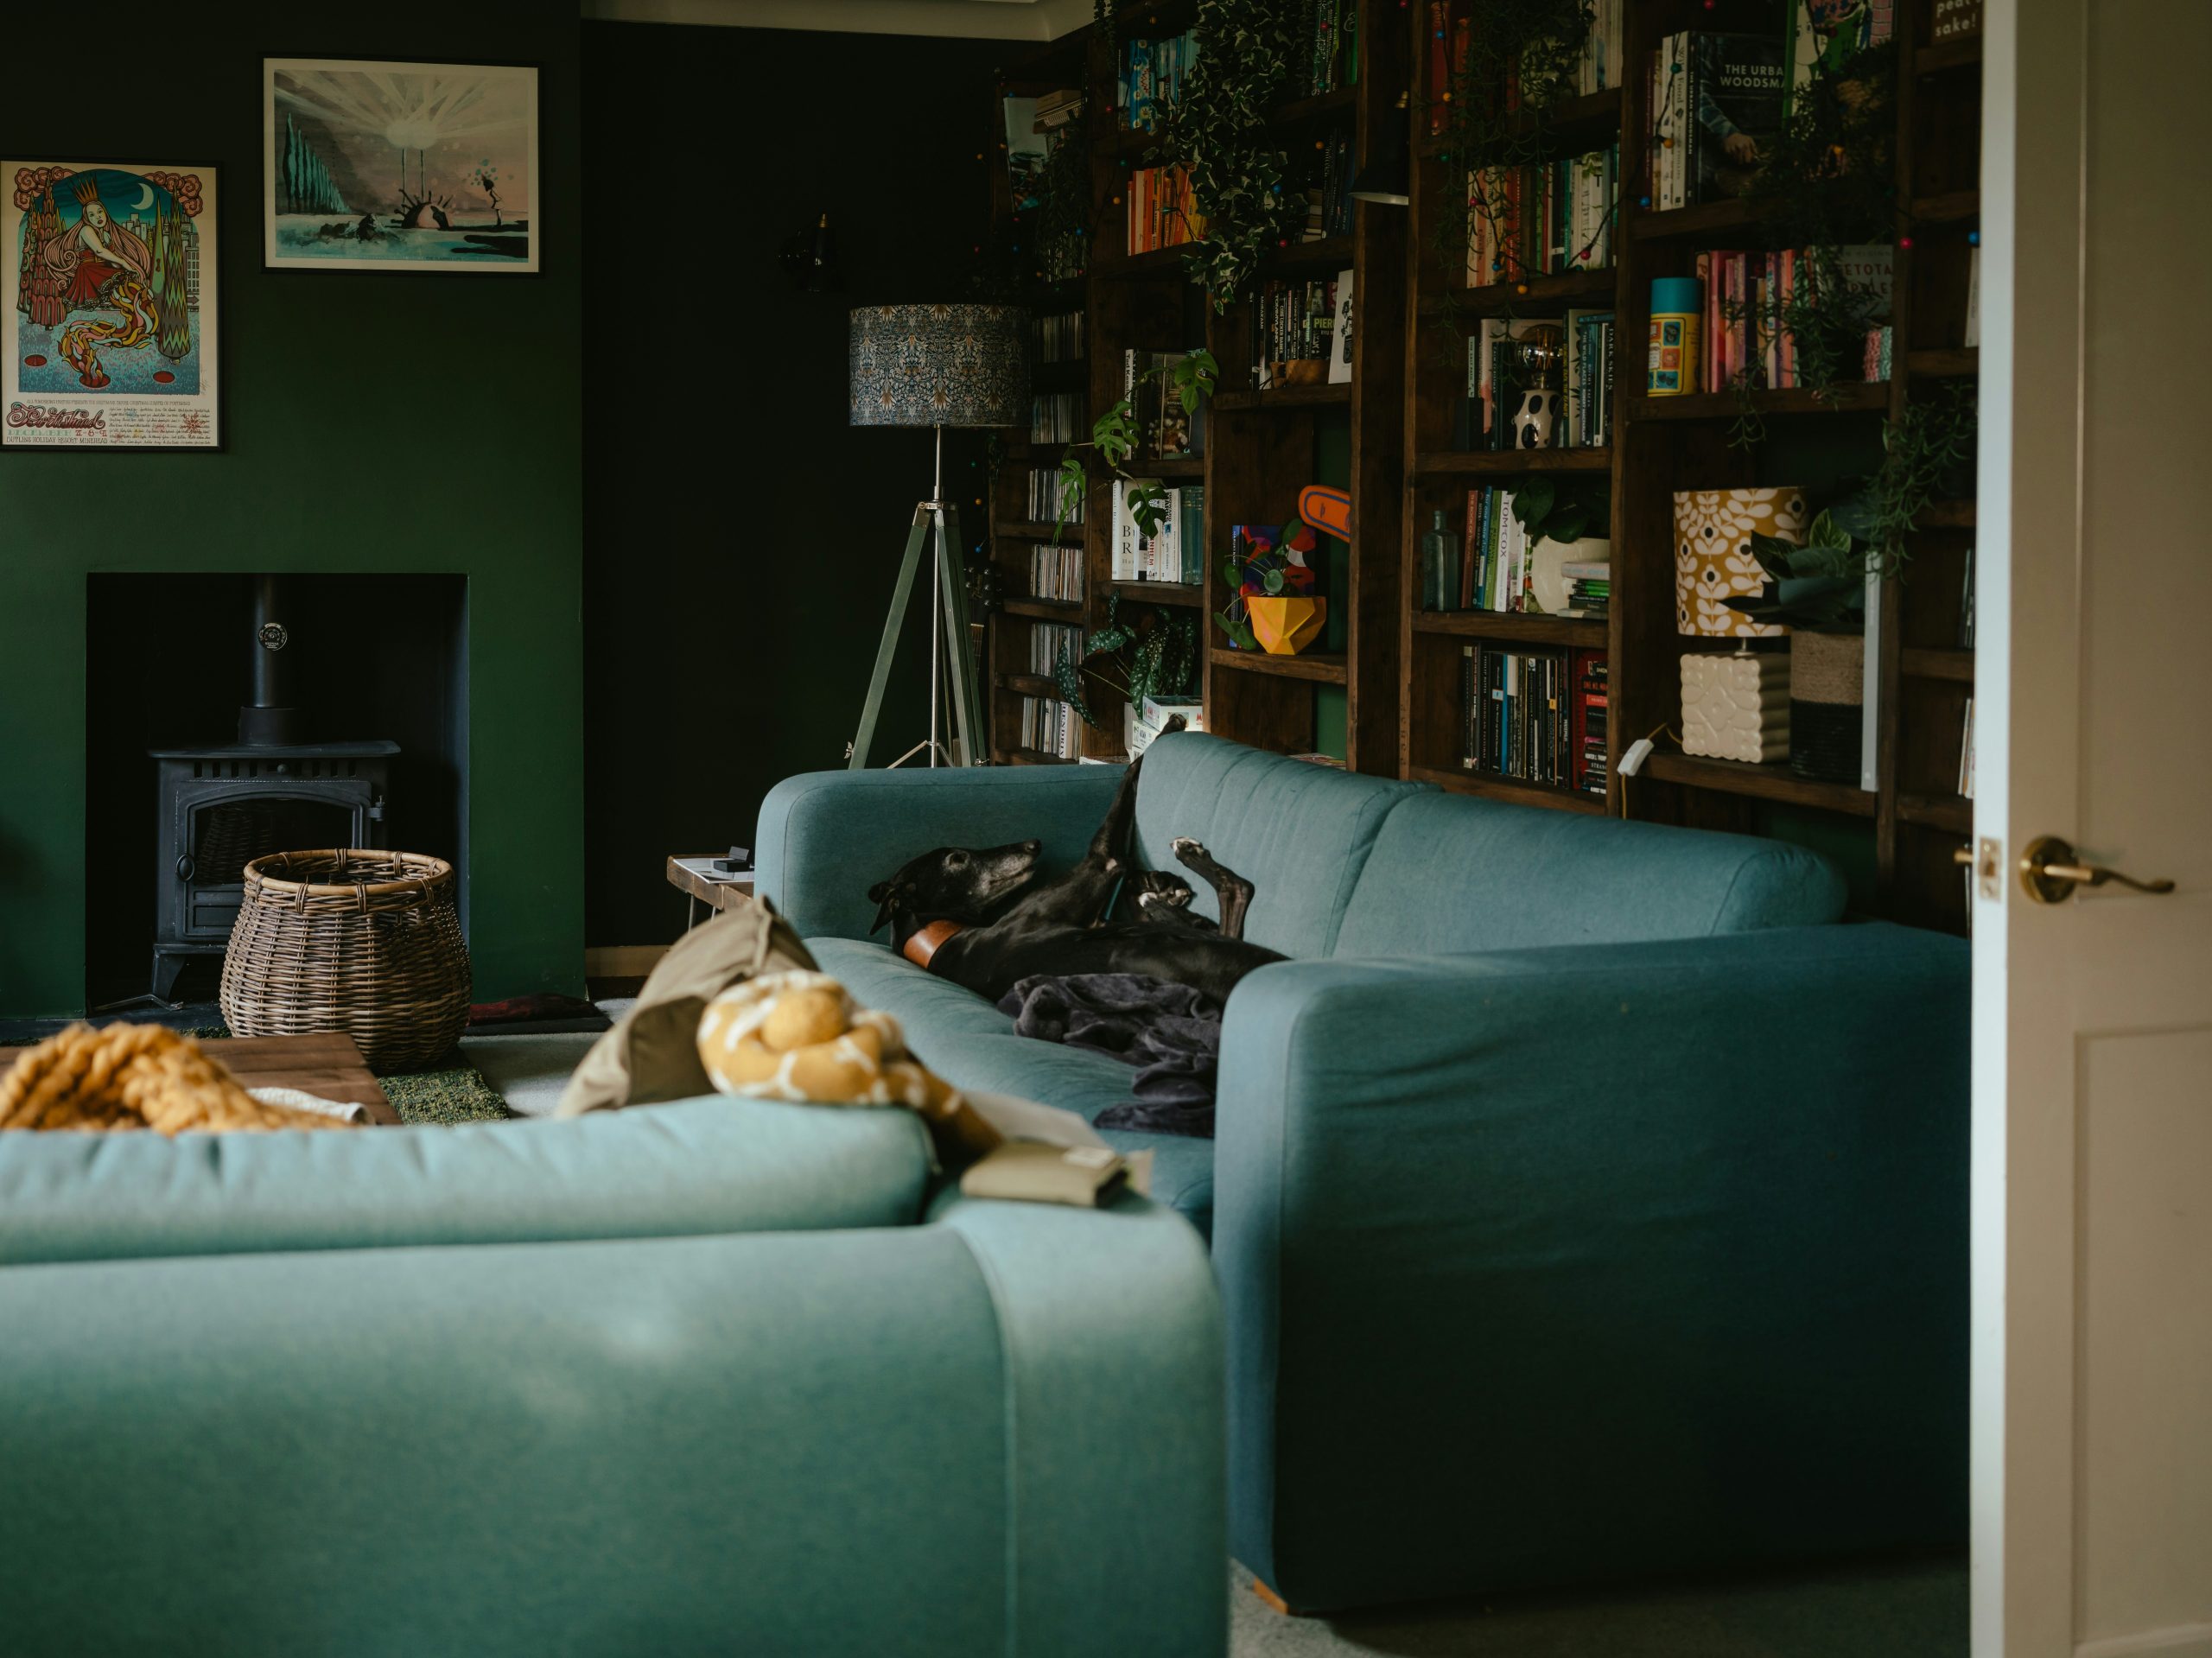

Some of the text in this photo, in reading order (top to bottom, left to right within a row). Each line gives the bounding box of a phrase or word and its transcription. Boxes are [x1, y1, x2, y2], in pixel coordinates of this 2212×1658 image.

[1936, 0, 1981, 19] pea
[1936, 13, 1976, 37] sake!
[1725, 64, 1783, 76] THE URBA
